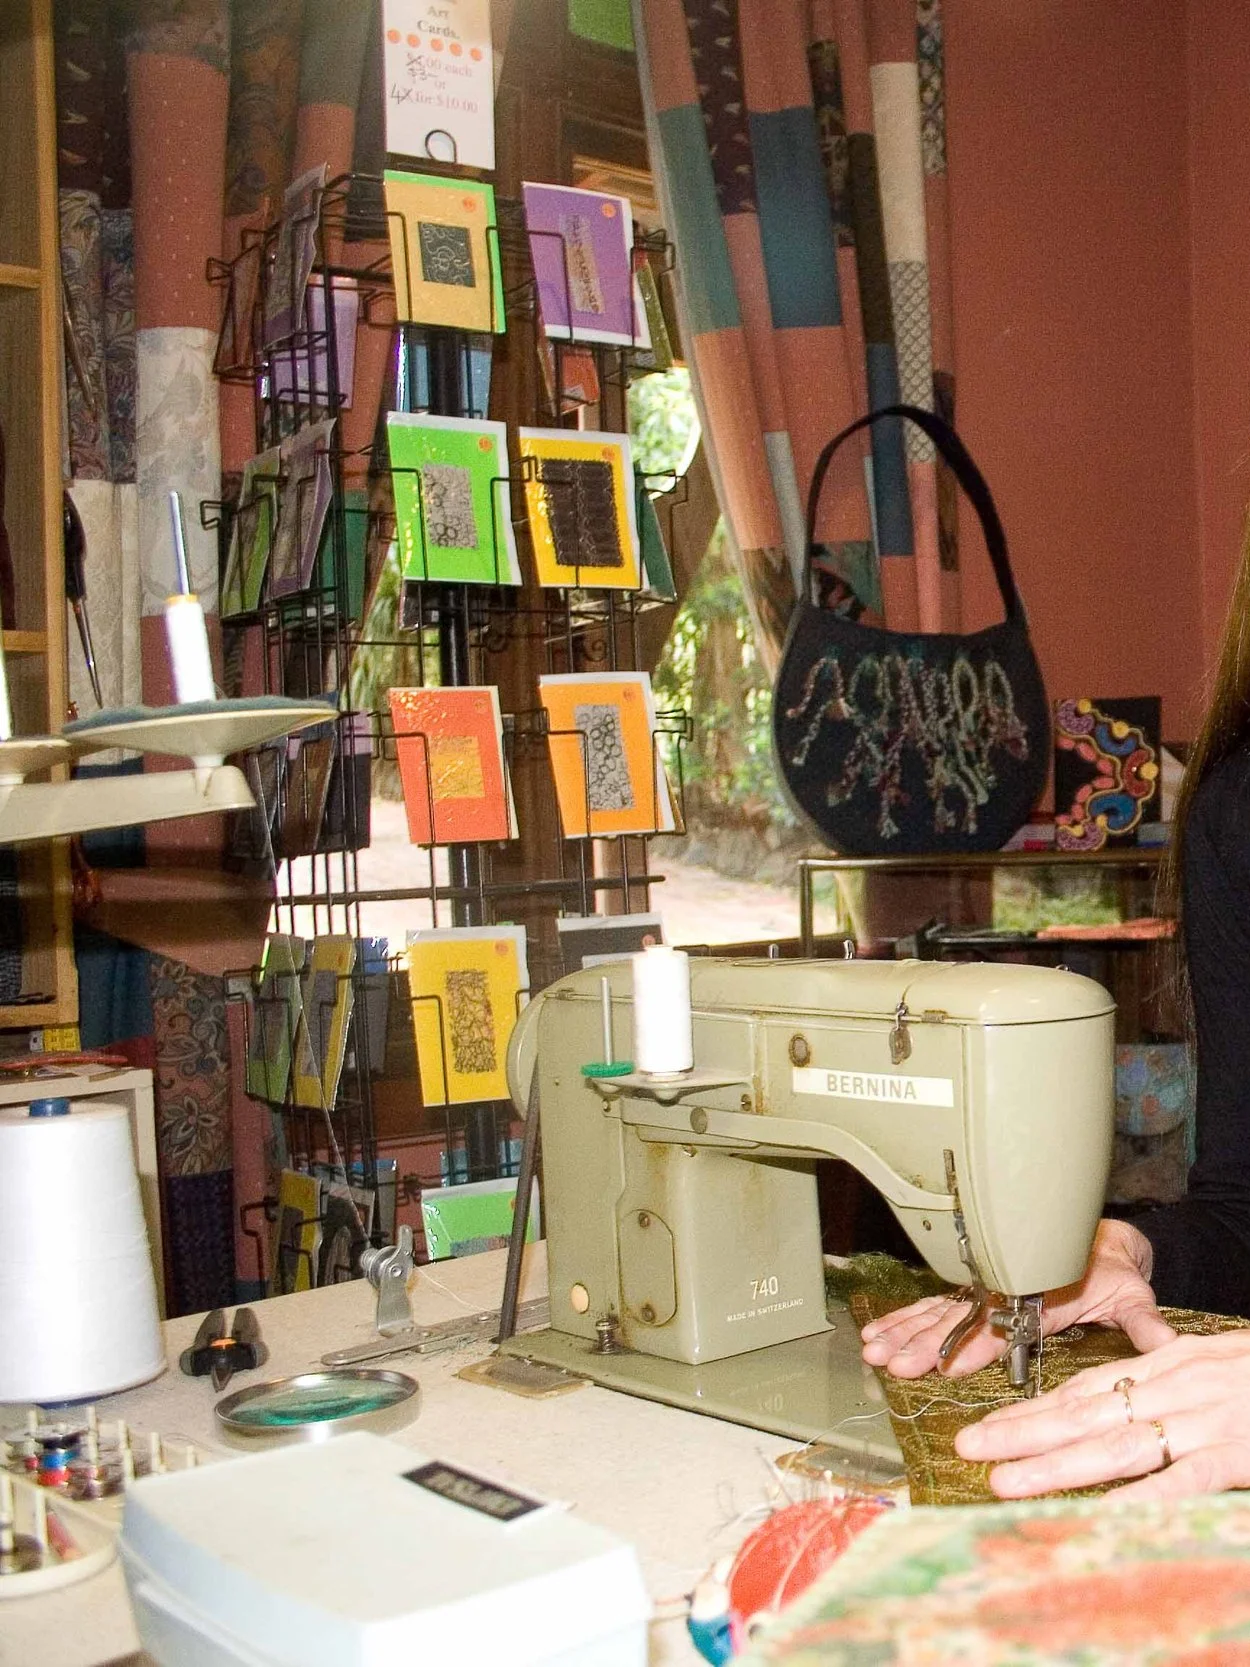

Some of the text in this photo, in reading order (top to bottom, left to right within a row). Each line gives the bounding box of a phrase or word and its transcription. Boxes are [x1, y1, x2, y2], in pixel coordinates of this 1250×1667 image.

[427, 6, 450, 18] Art
[445, 63, 473, 77] each
[827, 1074, 917, 1099] BERNINA
[750, 1276, 779, 1300] 740
[727, 1298, 804, 1322] MADE IN SWITZERLAND
